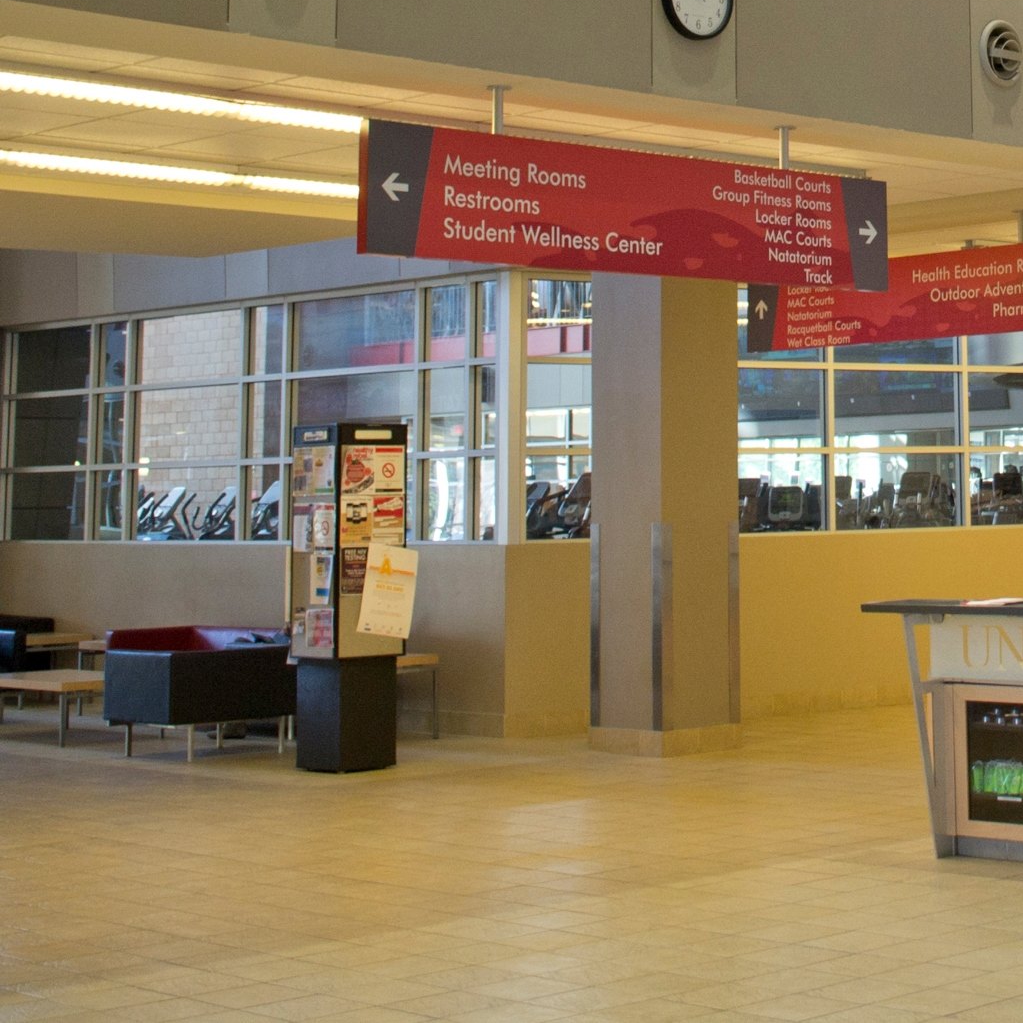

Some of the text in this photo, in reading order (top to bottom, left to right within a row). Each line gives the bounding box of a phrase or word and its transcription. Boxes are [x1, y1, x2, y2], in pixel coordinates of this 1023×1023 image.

[675, 1, 681, 11] 8
[683, 13, 689, 24] 7
[695, 19, 702, 30] 6
[707, 17, 713, 28] 5
[444, 154, 587, 189] Meeting Rooms
[734, 169, 831, 194] Basketball Courts
[444, 185, 540, 215] Restrooms
[712, 185, 832, 212] Group Fitness Rooms
[755, 208, 832, 230] Locker Rooms
[443, 217, 663, 256] Student Wellness Center
[764, 229, 832, 248] MAC Courts
[768, 248, 832, 266] Natatorium
[803, 268, 833, 284] Track
[911, 265, 950, 284] Health
[954, 260, 1013, 280] Education
[787, 296, 835, 308] MAC Courts
[930, 284, 980, 302] Outdoor
[787, 309, 832, 322] Natatorium
[787, 320, 861, 336] Racquetball Courts
[787, 335, 851, 348] Wet Class Room
